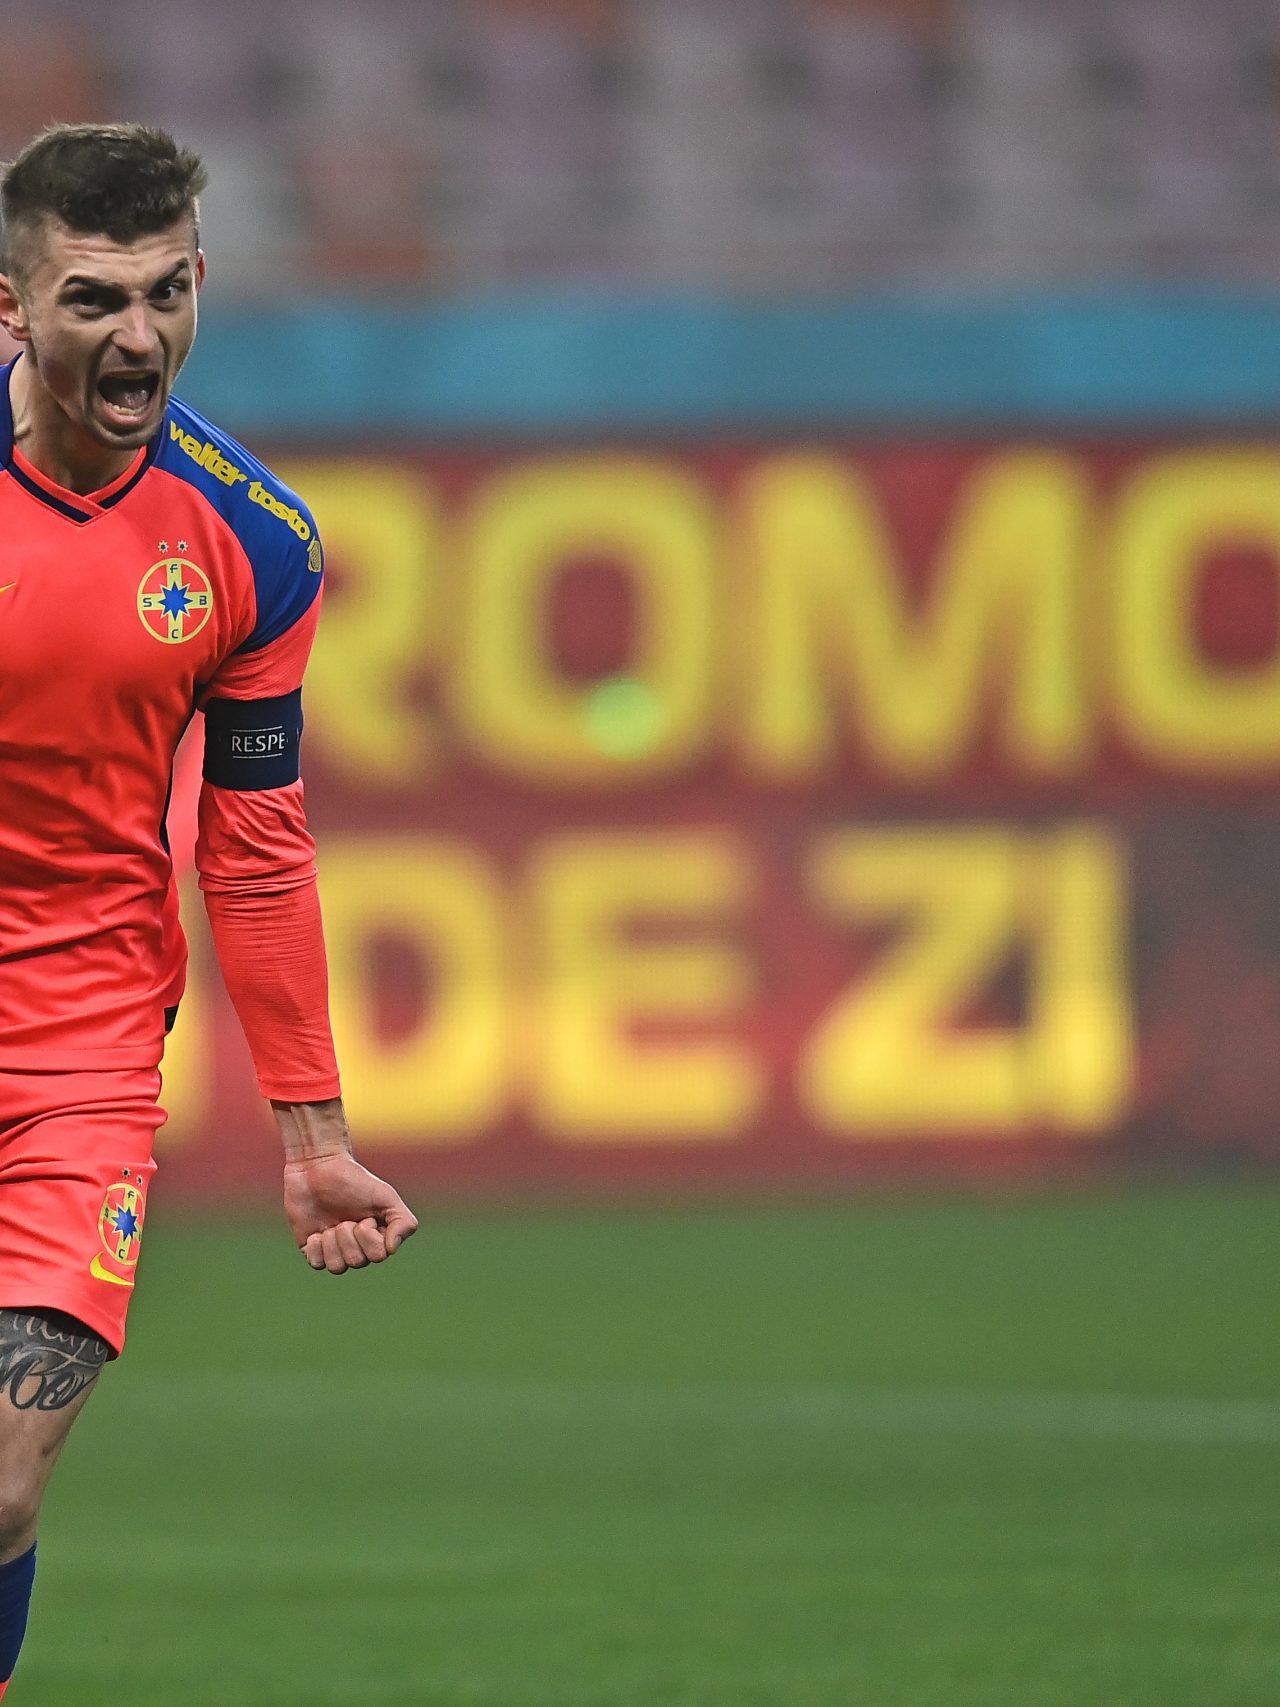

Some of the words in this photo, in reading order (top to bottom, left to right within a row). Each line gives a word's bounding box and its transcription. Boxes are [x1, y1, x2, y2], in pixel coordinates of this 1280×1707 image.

[170, 420, 248, 487] walter
[247, 481, 311, 541] tosto
[142, 597, 153, 608] S
[199, 595, 208, 606] B
[171, 628, 179, 639] C
[231, 732, 288, 753] RESPE
[312, 825, 760, 1148] DE
[798, 820, 1132, 1145] ZI
